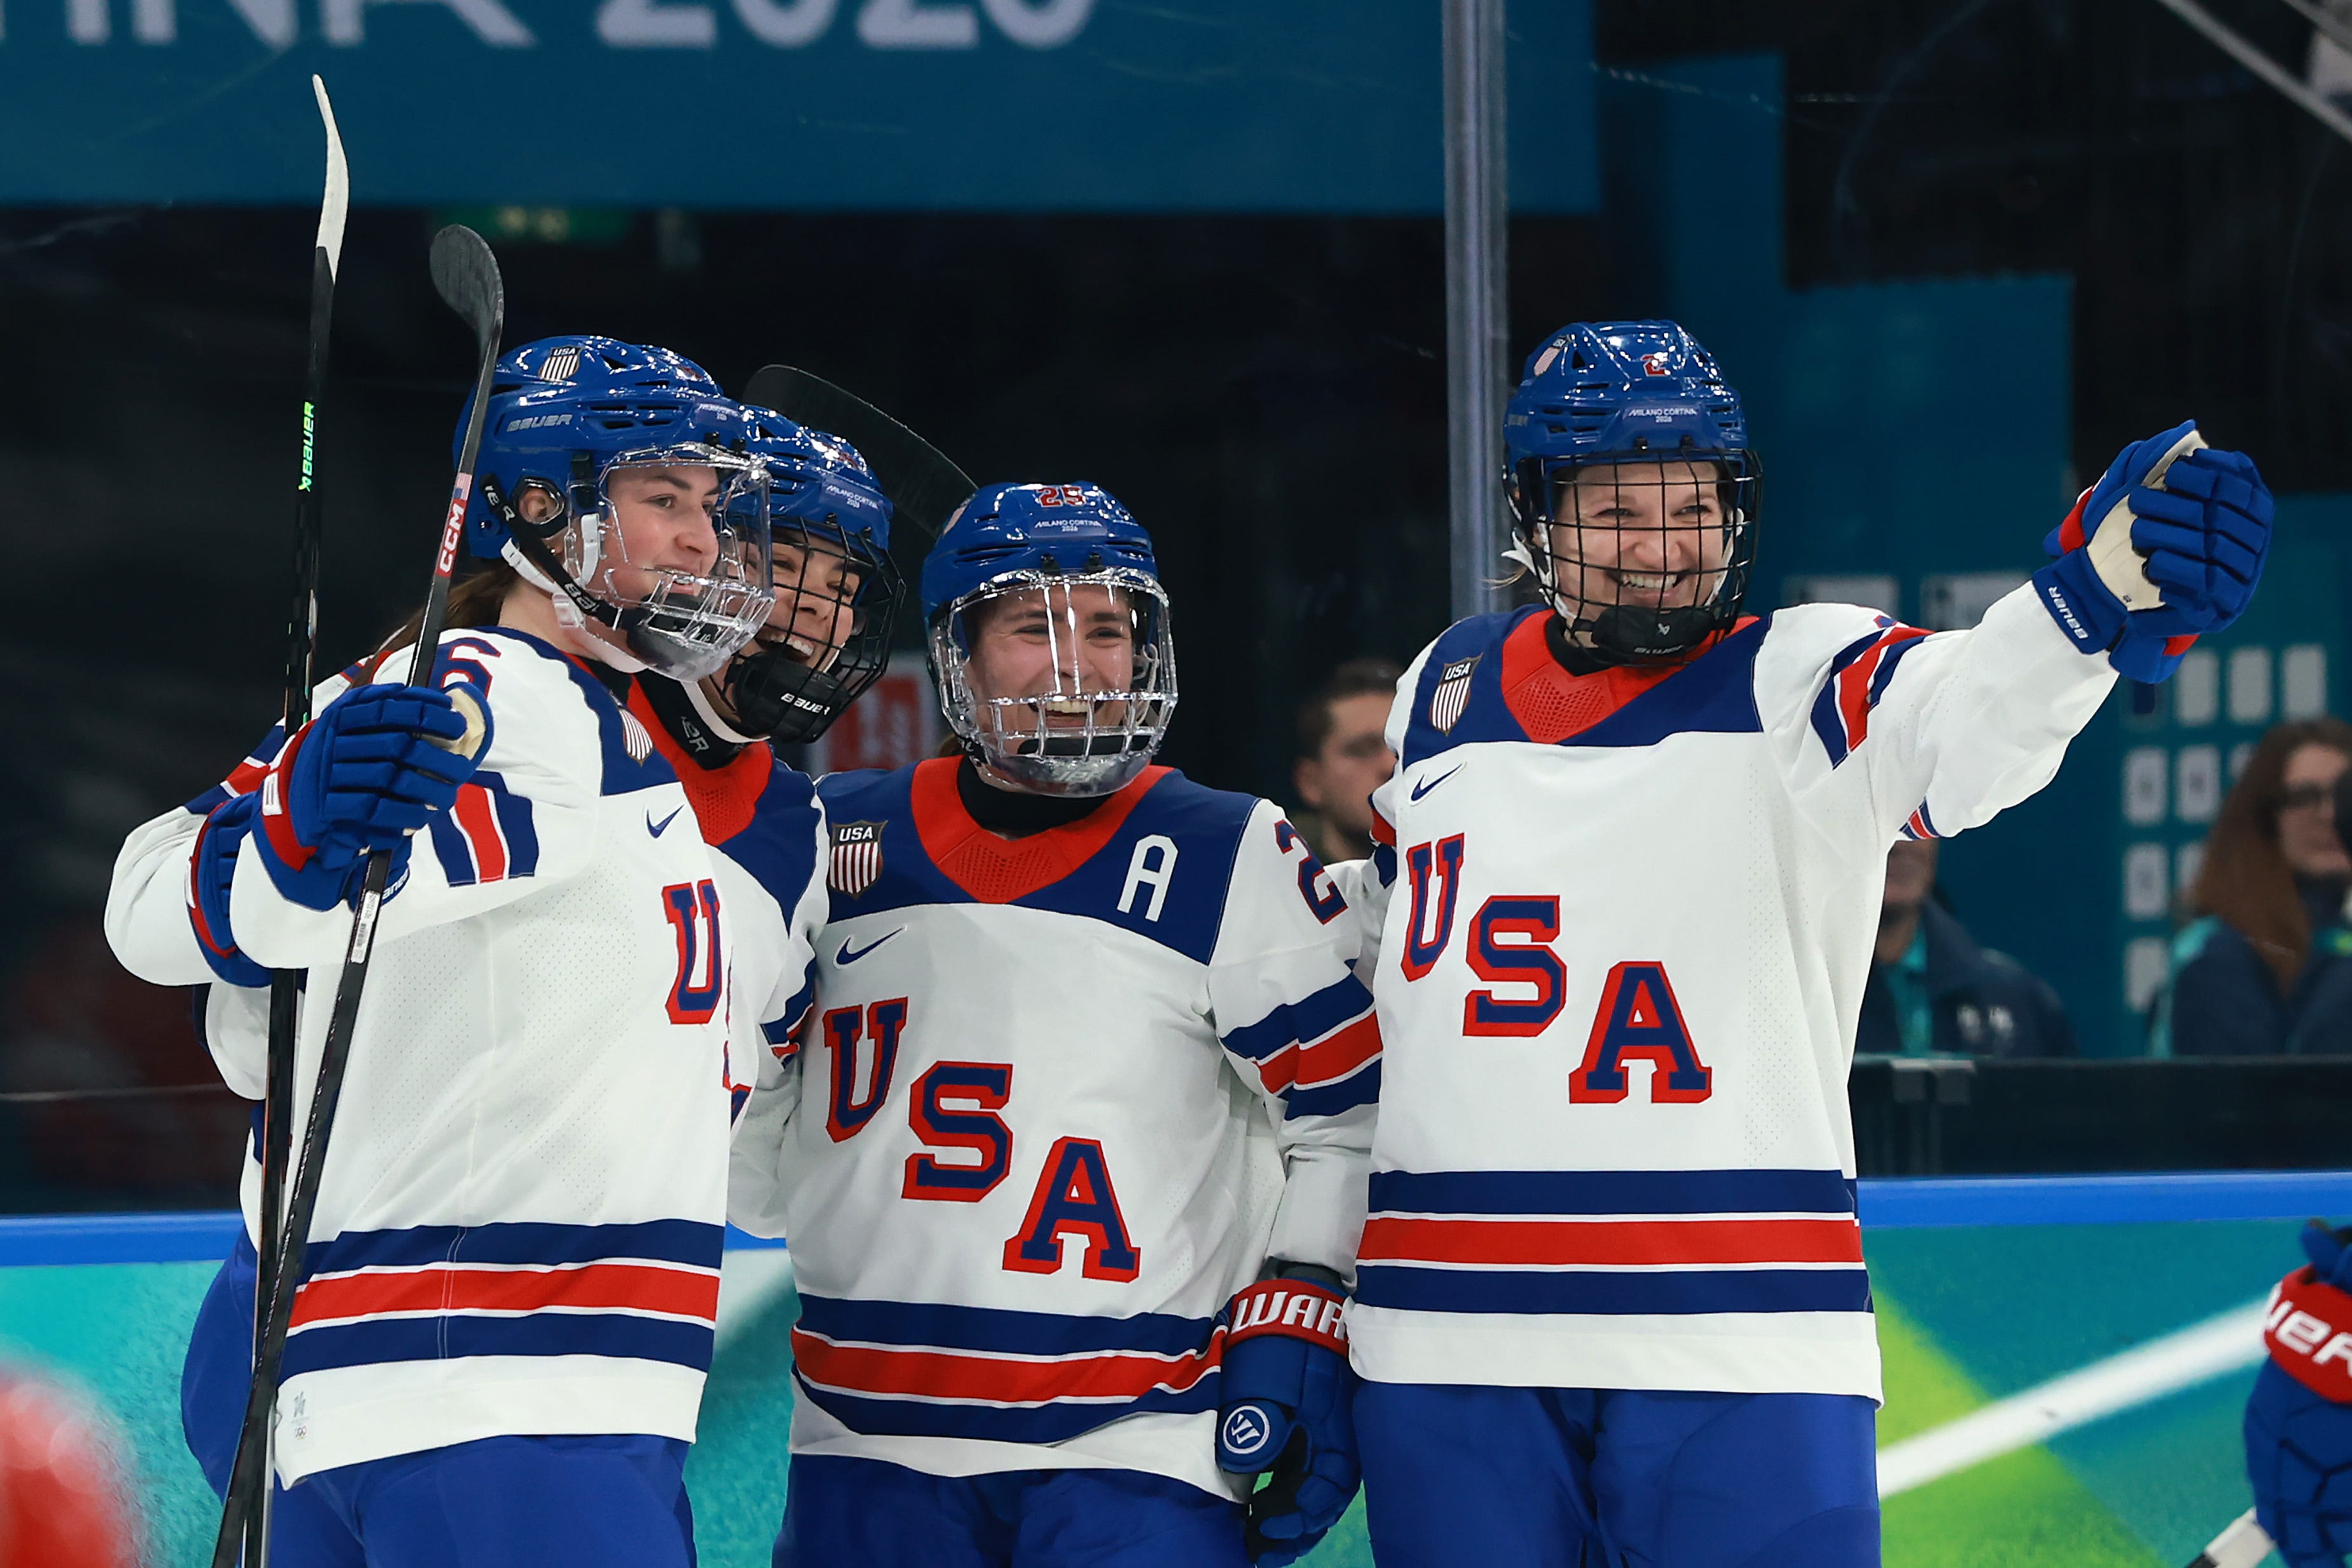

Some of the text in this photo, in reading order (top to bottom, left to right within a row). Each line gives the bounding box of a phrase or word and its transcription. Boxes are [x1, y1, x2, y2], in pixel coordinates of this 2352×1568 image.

[553, 347, 576, 356] USA
[1640, 352, 1671, 377] 2
[303, 401, 315, 476] BAUER
[507, 414, 573, 432] BAUER
[1036, 484, 1087, 507] 25
[439, 503, 465, 573] CCM
[1445, 661, 1471, 681] USA
[839, 826, 874, 842] USA
[1117, 834, 1179, 922] A
[1274, 819, 1350, 926] 2
[1400, 832, 1713, 1105] USA
[823, 997, 1141, 1283] USA
